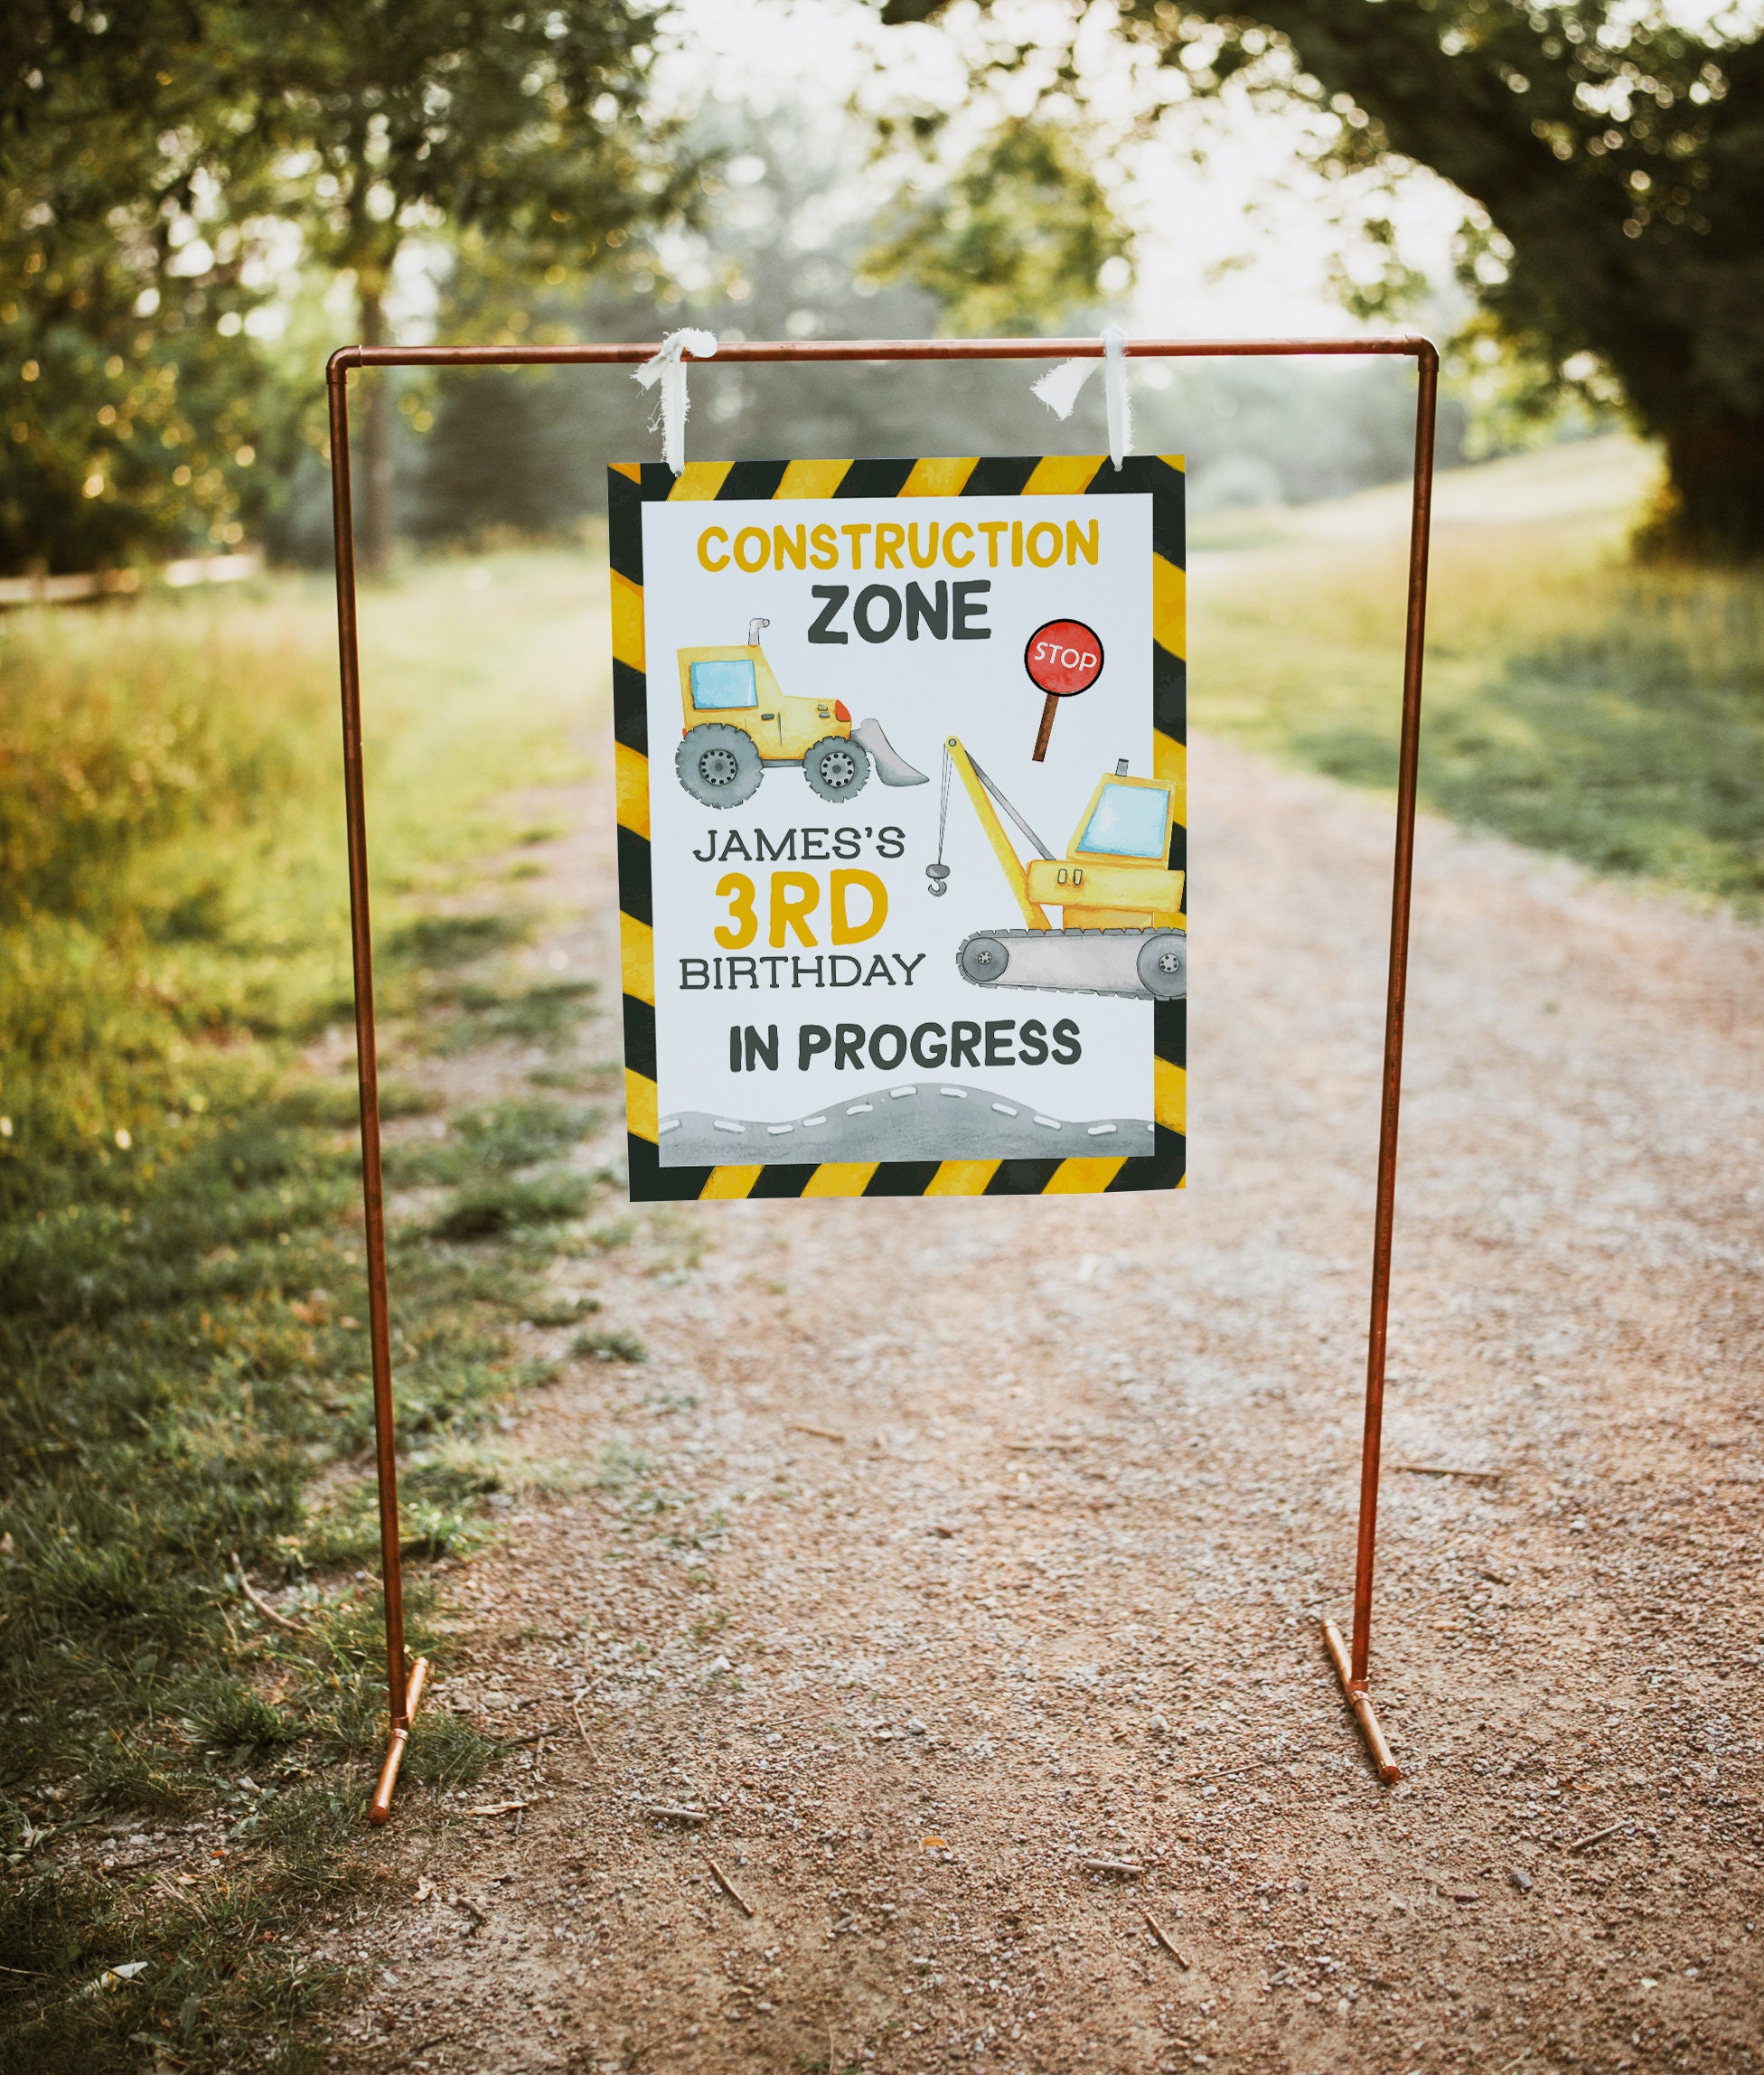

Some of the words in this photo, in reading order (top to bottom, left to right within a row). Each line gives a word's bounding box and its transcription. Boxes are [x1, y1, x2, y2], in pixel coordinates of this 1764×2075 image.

[697, 518, 1100, 574] CONSTRUCTION
[807, 579, 992, 645] ZONE
[1034, 642, 1097, 671] STOP
[692, 826, 906, 862] JAMES’S
[713, 868, 888, 950] 3RD
[679, 953, 926, 991] BIRTHDAY
[729, 1024, 779, 1073] IN
[798, 1018, 1083, 1072] PROGRESS
